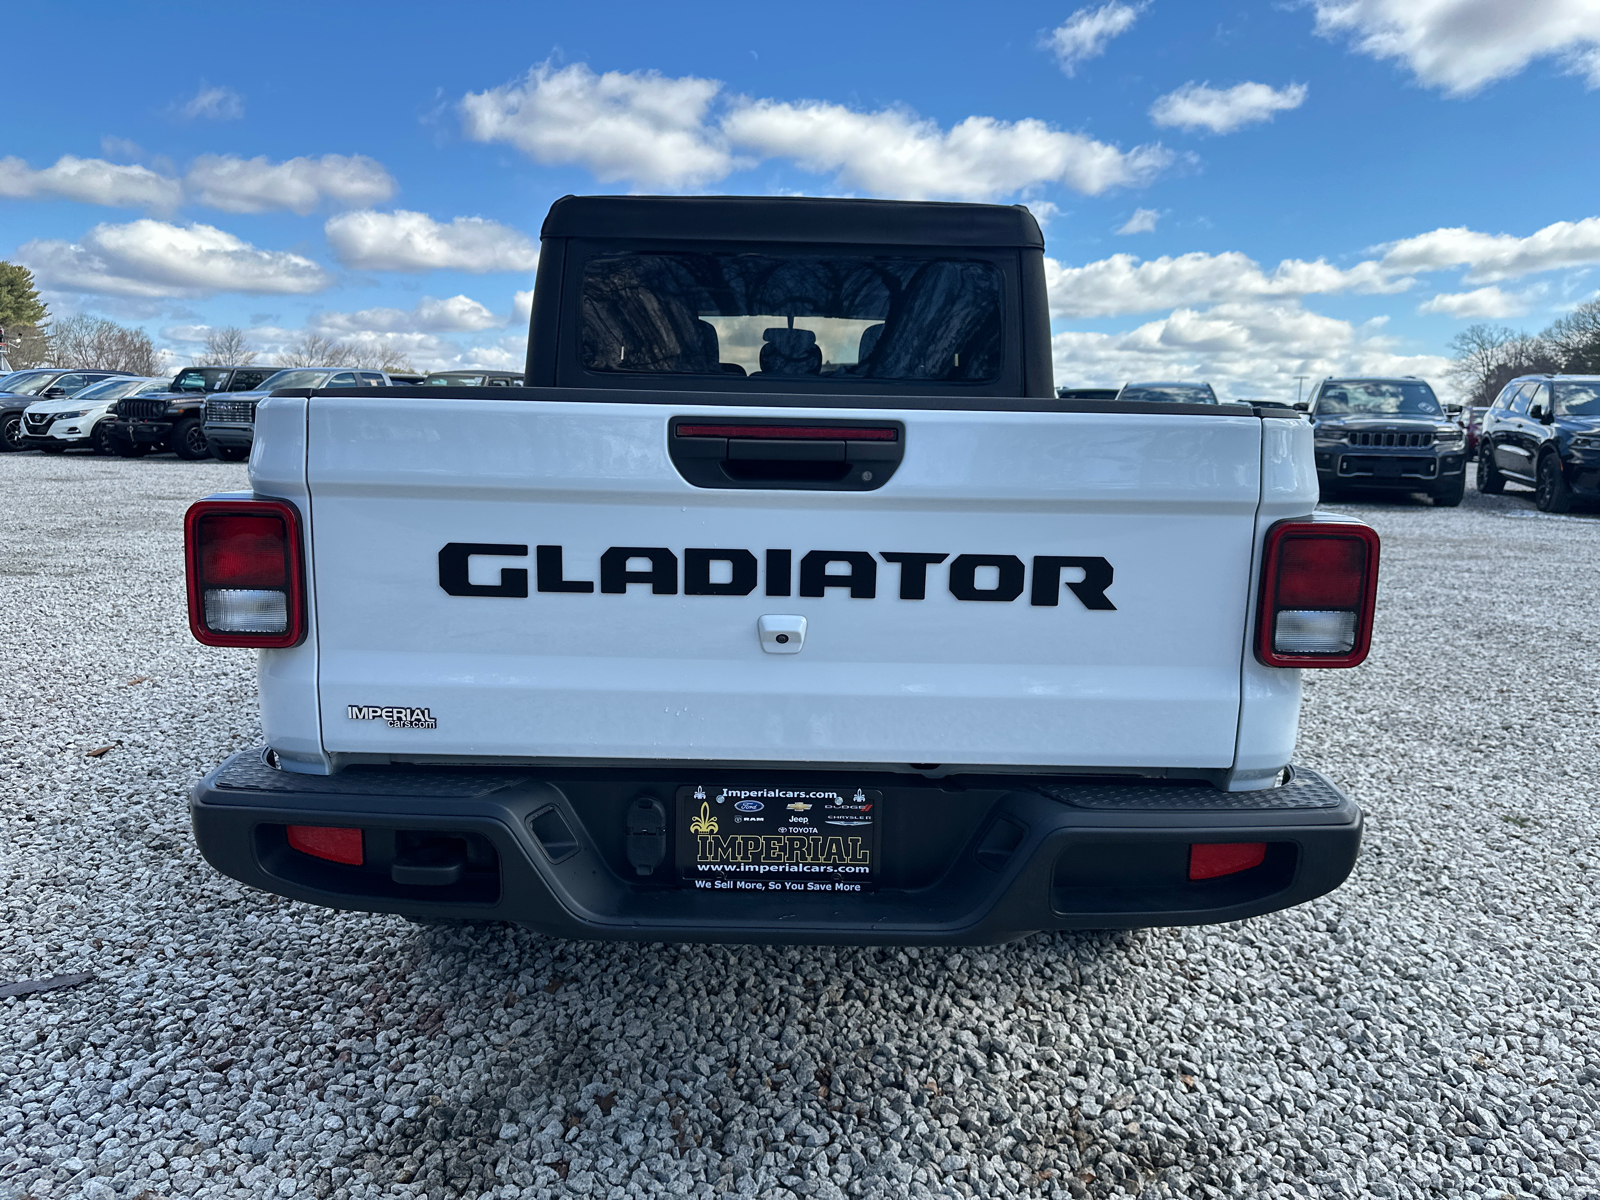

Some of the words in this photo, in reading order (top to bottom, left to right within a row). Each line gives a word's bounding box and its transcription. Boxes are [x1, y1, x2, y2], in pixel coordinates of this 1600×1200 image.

[438, 542, 1118, 611] GLADIATOR
[347, 705, 436, 722] IMPERIAL
[387, 720, 437, 729] cars.com
[722, 788, 837, 799] Imperialcars.com
[788, 815, 809, 824] Jeep
[788, 826, 819, 834] TOYOTA
[697, 834, 870, 864] IMPERIAL
[697, 863, 870, 874] www.imperialcars.com
[695, 880, 712, 888] We
[714, 880, 734, 889] Sell
[736, 881, 766, 891] More,
[768, 881, 782, 890] So
[784, 881, 805, 890] You
[806, 882, 832, 891] Save
[834, 882, 861, 892] More
